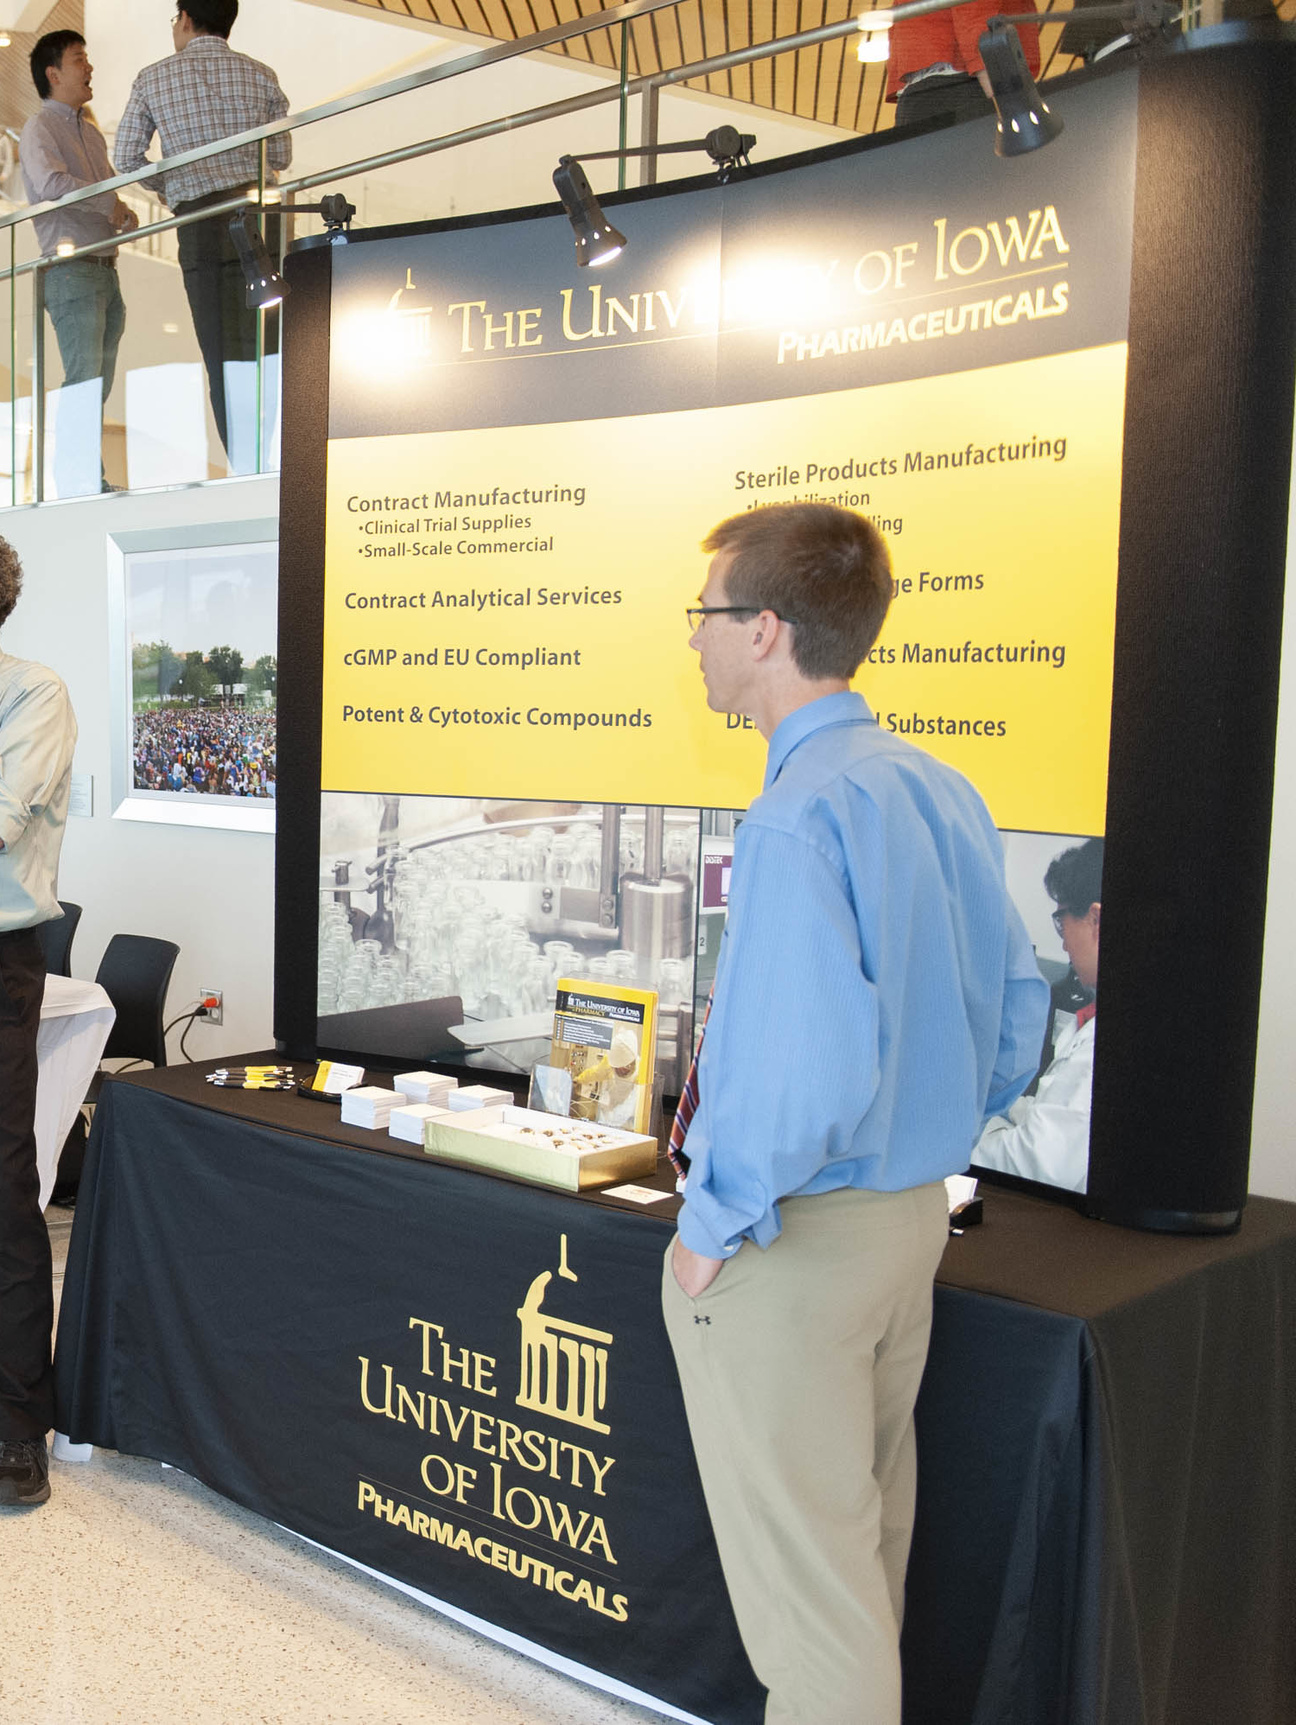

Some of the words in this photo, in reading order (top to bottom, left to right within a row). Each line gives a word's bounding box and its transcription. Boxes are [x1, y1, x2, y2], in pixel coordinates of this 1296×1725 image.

[447, 300, 543, 353] THE
[854, 241, 919, 295] OF
[933, 205, 1070, 282] IOWA
[777, 281, 1069, 365] PHARMACEUTICALS
[734, 466, 800, 490] Sterile
[805, 456, 898, 483] Products
[903, 435, 1067, 474] Manufacturing
[347, 494, 429, 512] Contract
[434, 484, 586, 509] Manufacturing
[424, 517, 457, 533] Trial
[461, 514, 532, 534] Supplies
[456, 536, 554, 555] Commercial
[919, 571, 985, 594] Forms
[345, 592, 426, 609] Contract
[431, 588, 532, 611] Analytical
[537, 586, 622, 606] Services
[343, 649, 398, 665] cGMP
[402, 648, 438, 666] and
[444, 649, 470, 666] EU
[475, 647, 581, 670] Compliant
[902, 640, 1066, 668] Manufacturing
[342, 705, 405, 723] Potent
[409, 706, 424, 723] &
[428, 706, 521, 728] Cytotoxic
[526, 708, 653, 730] Compounds
[886, 713, 1007, 736] Substances
[575, 997, 587, 1007] THE
[587, 1000, 618, 1013] UNIVERSITY
[408, 1316, 498, 1397] THE
[358, 1356, 616, 1497] UNIVERSITY
[420, 1454, 478, 1504] OF
[489, 1462, 618, 1566] IOWA
[357, 1481, 629, 1622] PHARMACEUTICALS
